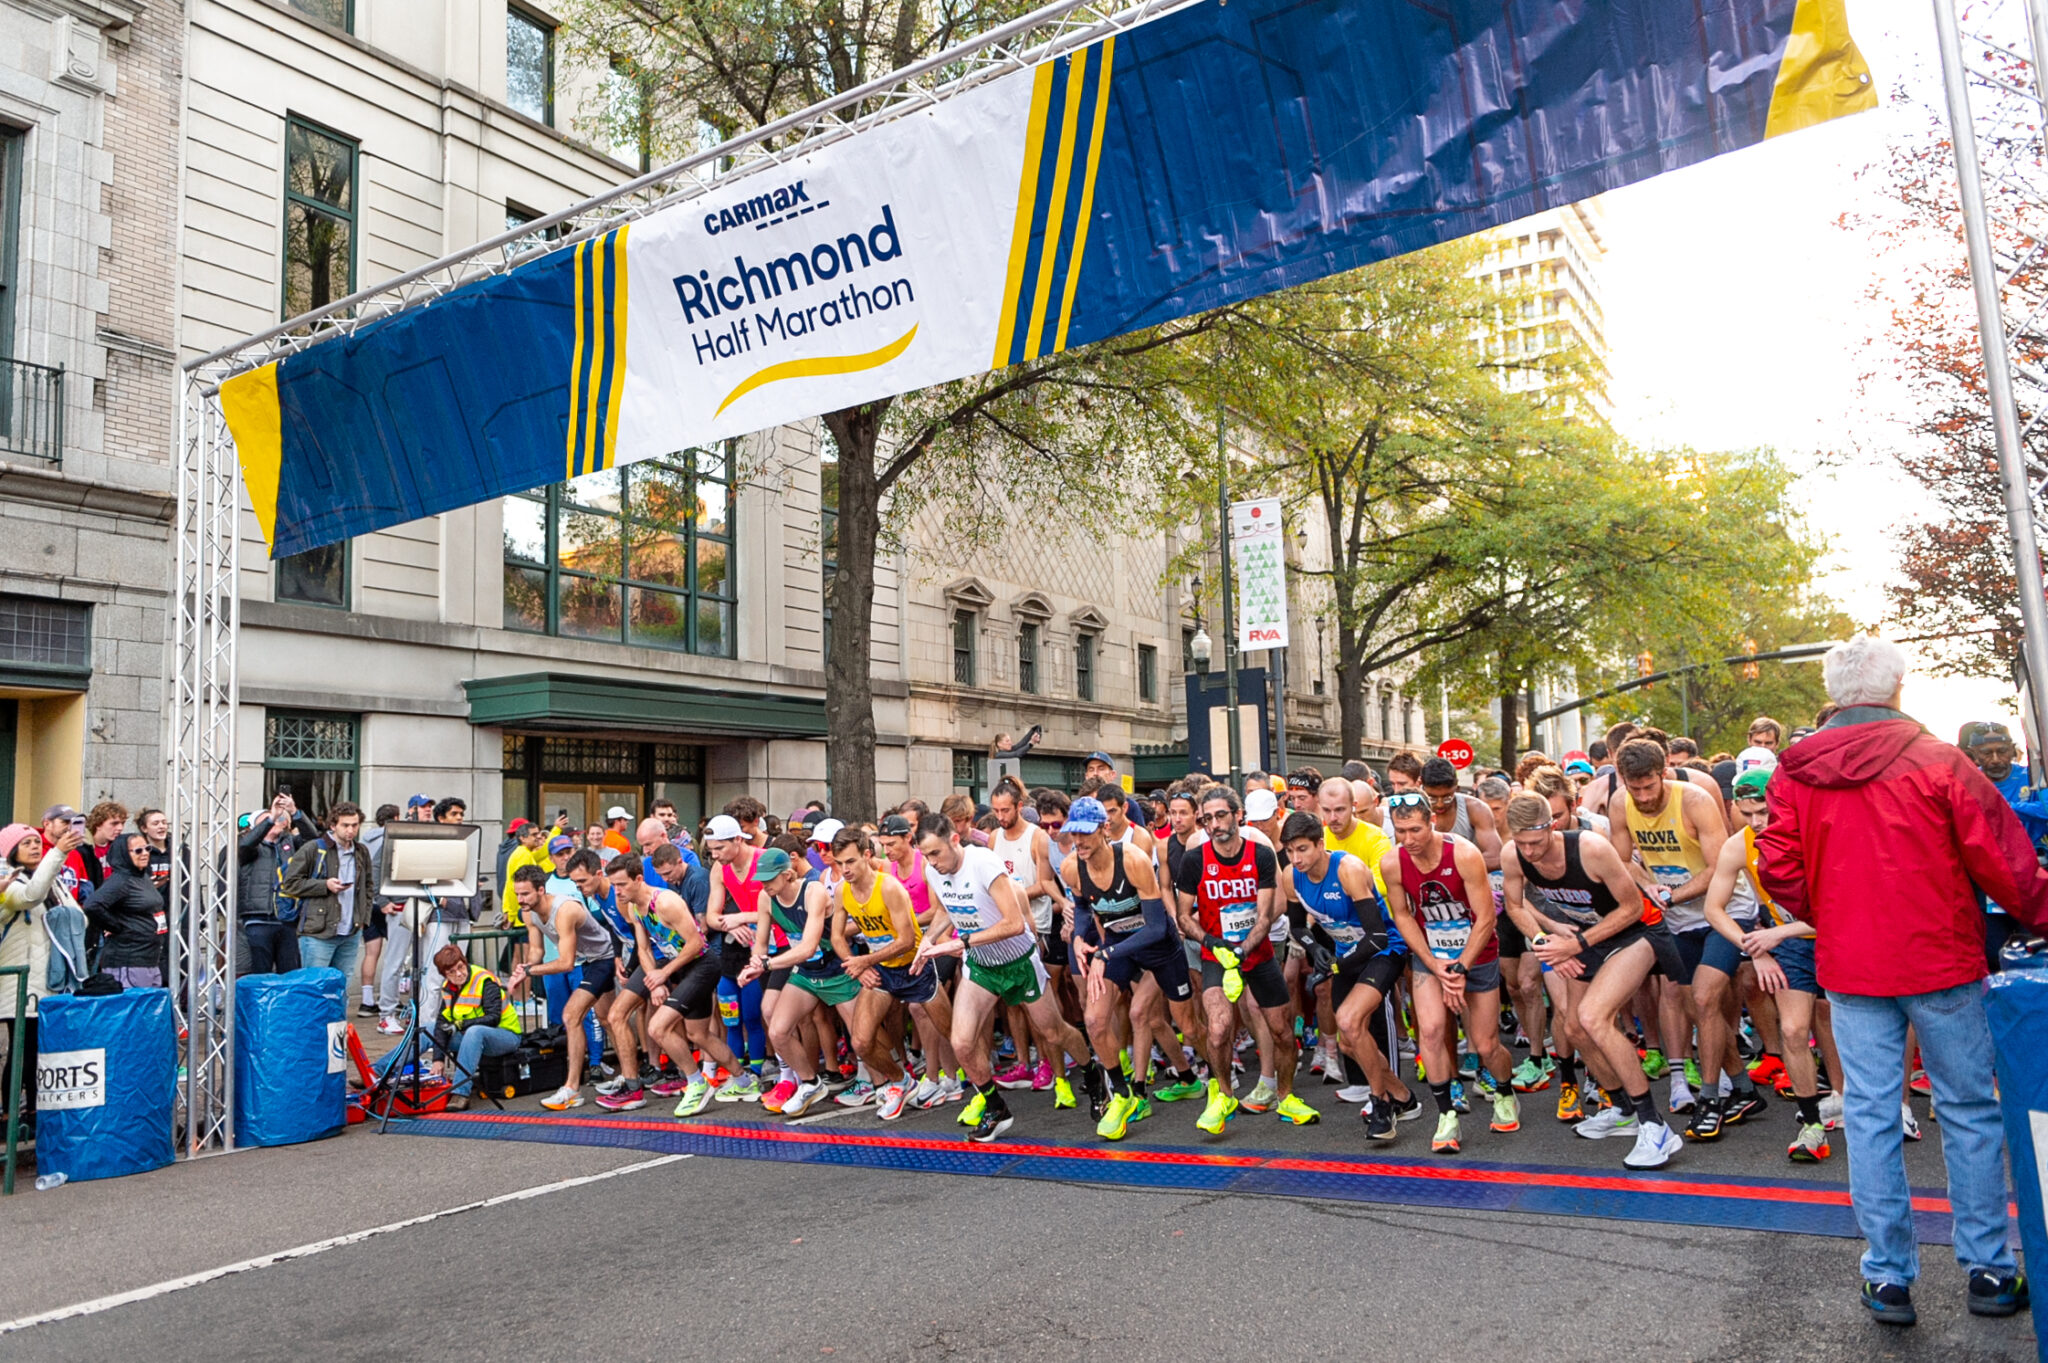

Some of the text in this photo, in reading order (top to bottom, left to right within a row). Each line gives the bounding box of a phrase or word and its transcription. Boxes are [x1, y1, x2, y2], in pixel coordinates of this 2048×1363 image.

[672, 204, 903, 324] Richmond
[691, 278, 915, 365] Half Marathon
[1249, 629, 1281, 642] RVA
[1440, 749, 1470, 761] 1:30
[1635, 830, 1679, 845] NOVA
[1204, 878, 1258, 900] DCRR
[1323, 891, 1342, 900] GRC
[1436, 938, 1466, 948] 16342
[37, 1062, 98, 1089] PORTS
